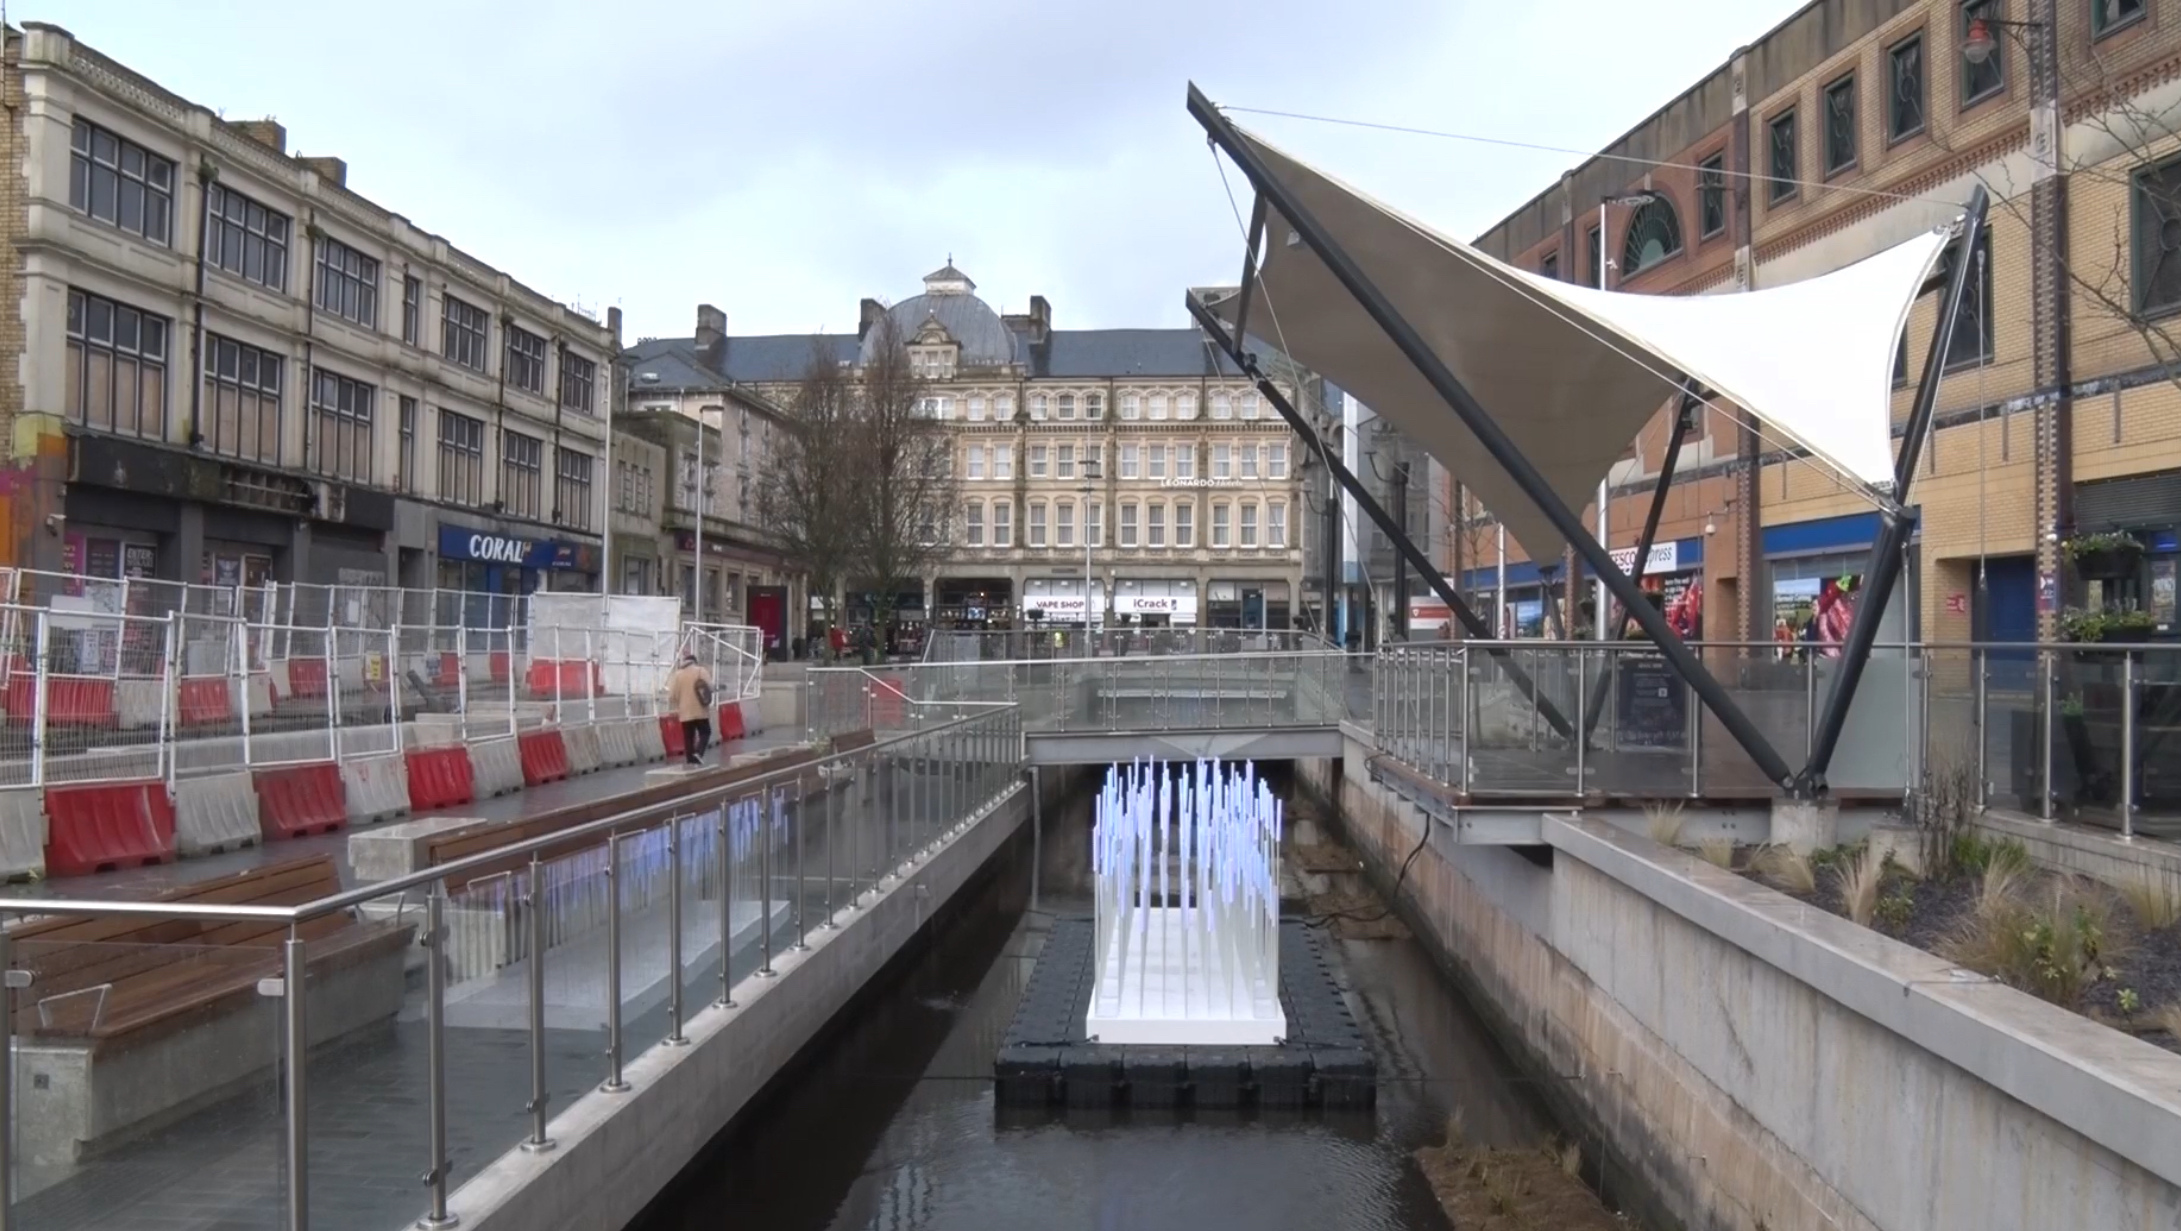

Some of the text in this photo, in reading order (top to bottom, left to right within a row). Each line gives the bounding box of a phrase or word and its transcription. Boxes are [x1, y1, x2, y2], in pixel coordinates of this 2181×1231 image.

[1161, 479, 1215, 488] LEONARDO
[469, 534, 523, 563] CORAL
[1648, 547, 1673, 568] press
[1036, 601, 1084, 609] VAPE SHOP
[1133, 599, 1168, 609] iCrack
